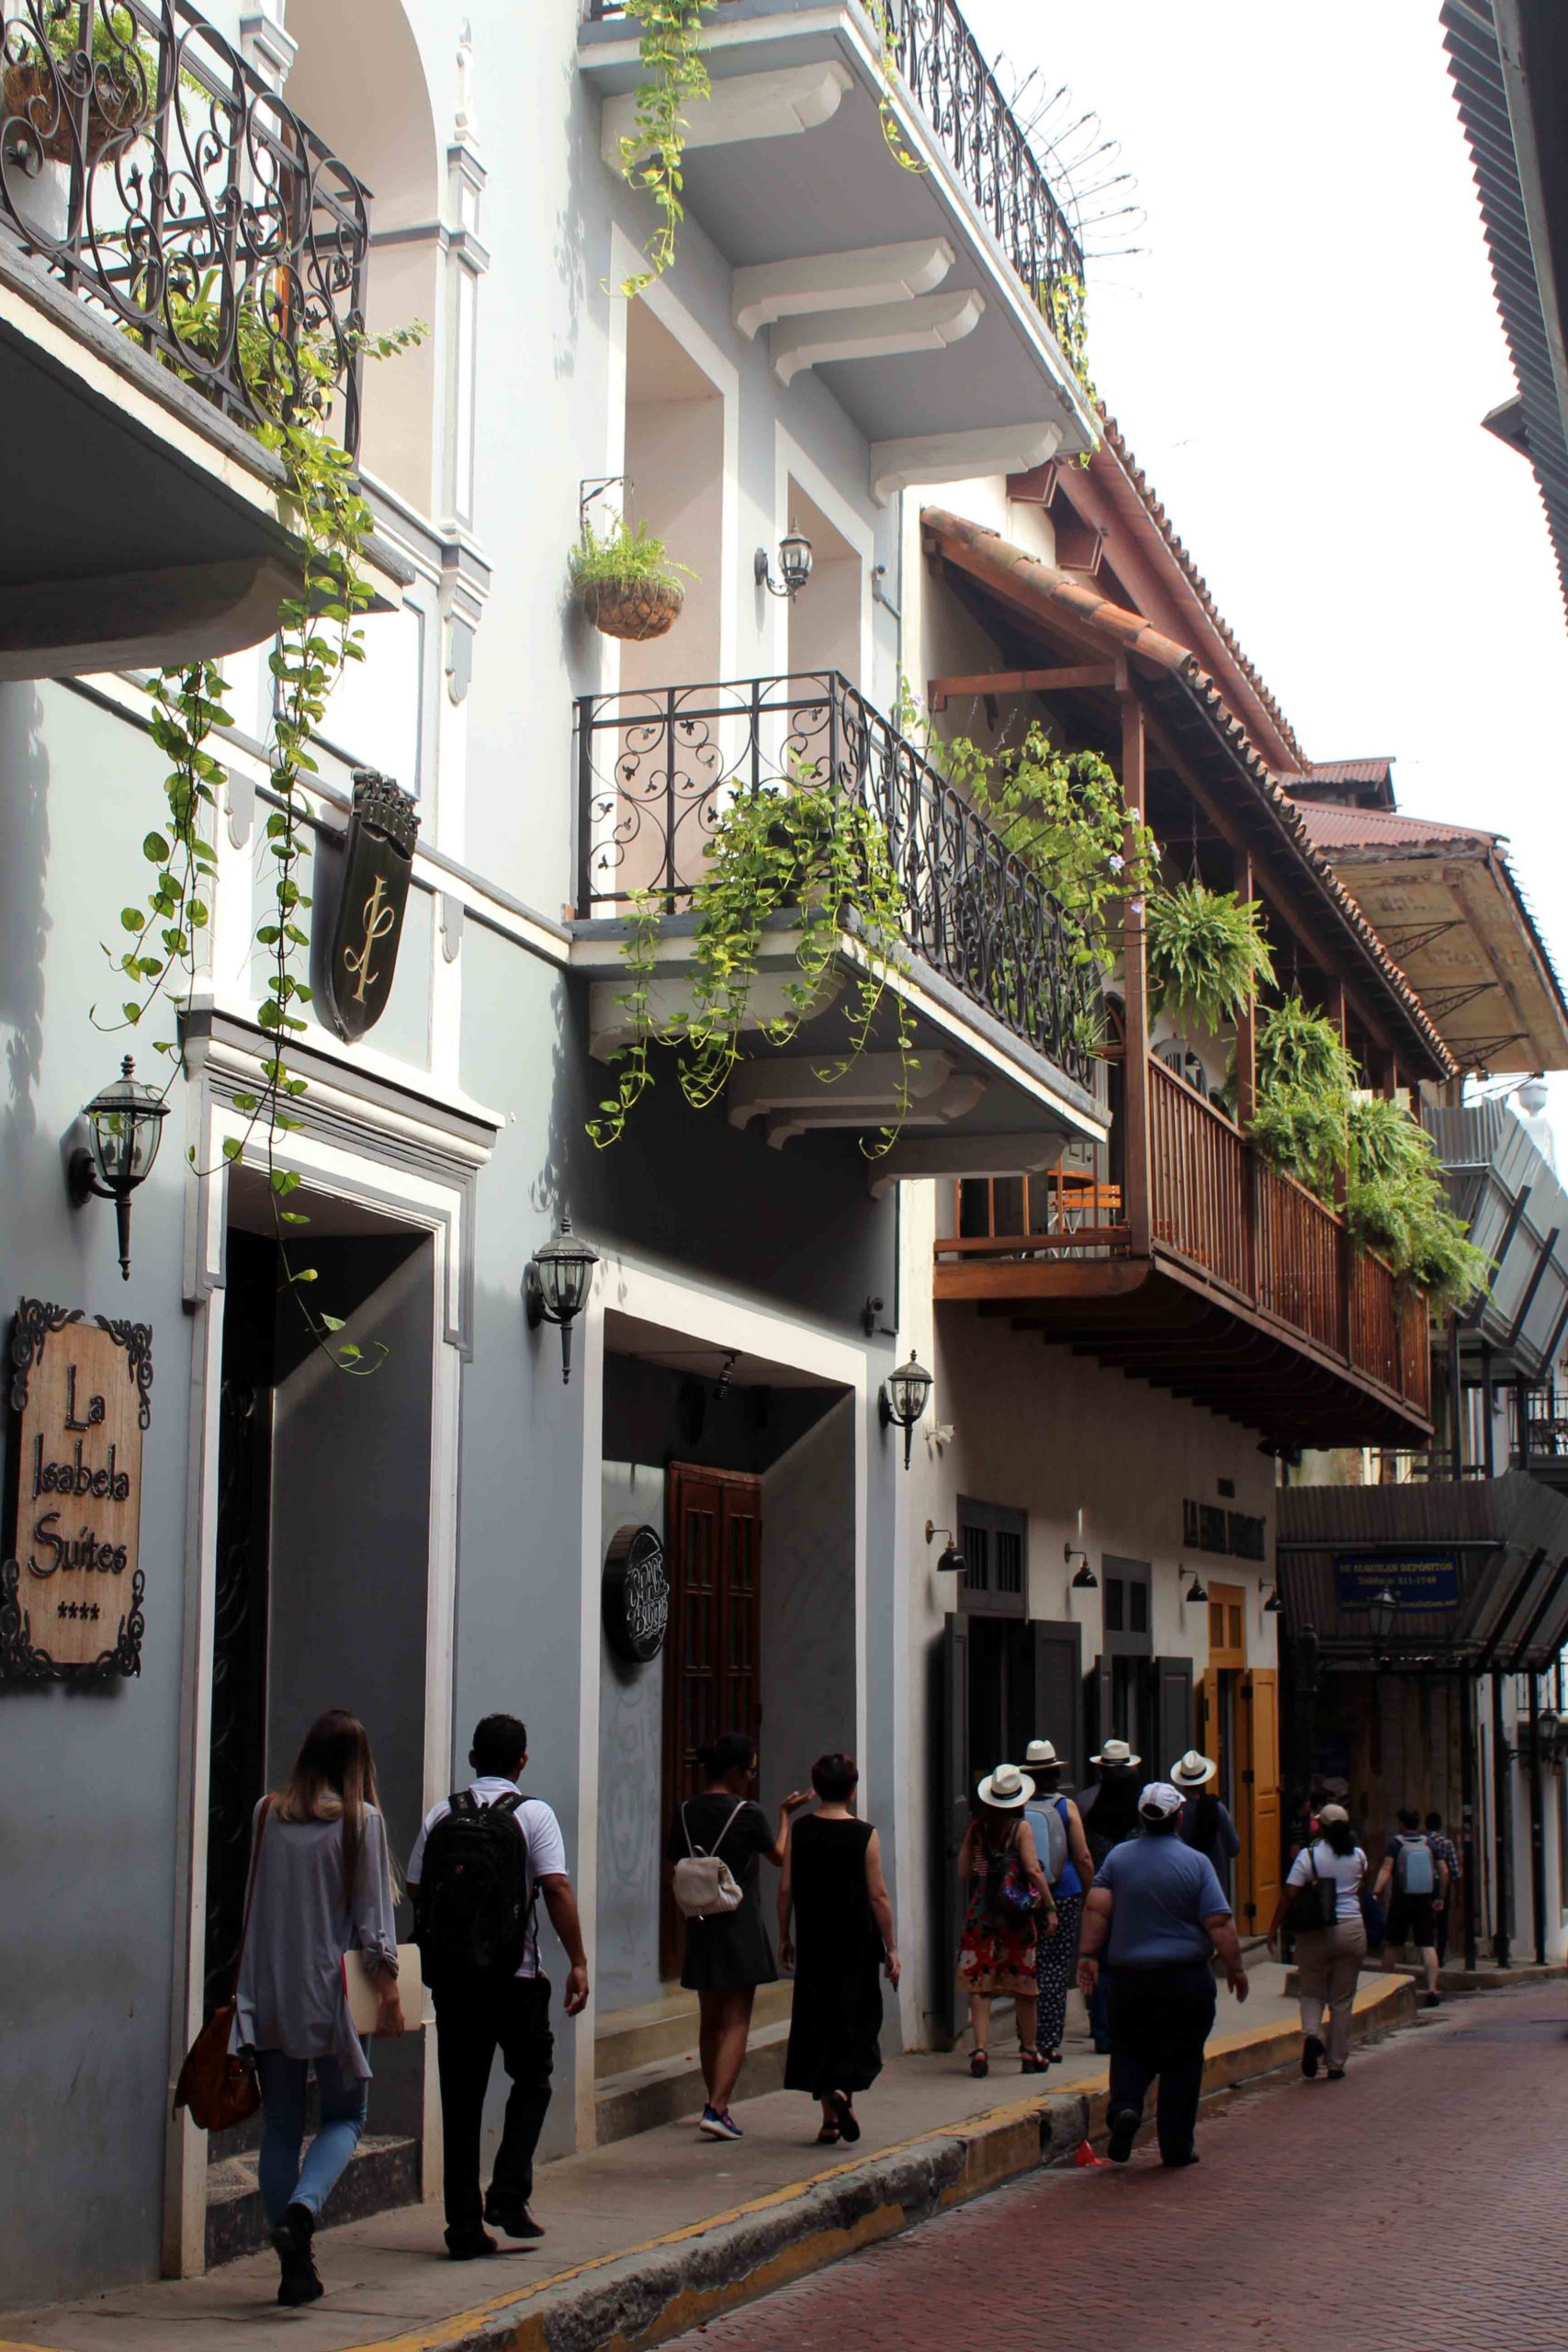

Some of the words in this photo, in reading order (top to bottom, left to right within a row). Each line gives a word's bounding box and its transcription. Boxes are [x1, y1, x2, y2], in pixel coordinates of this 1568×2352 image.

[65, 1363, 106, 1431] La
[32, 1433, 130, 1501] Isabela
[28, 1512, 127, 1578] Suites
